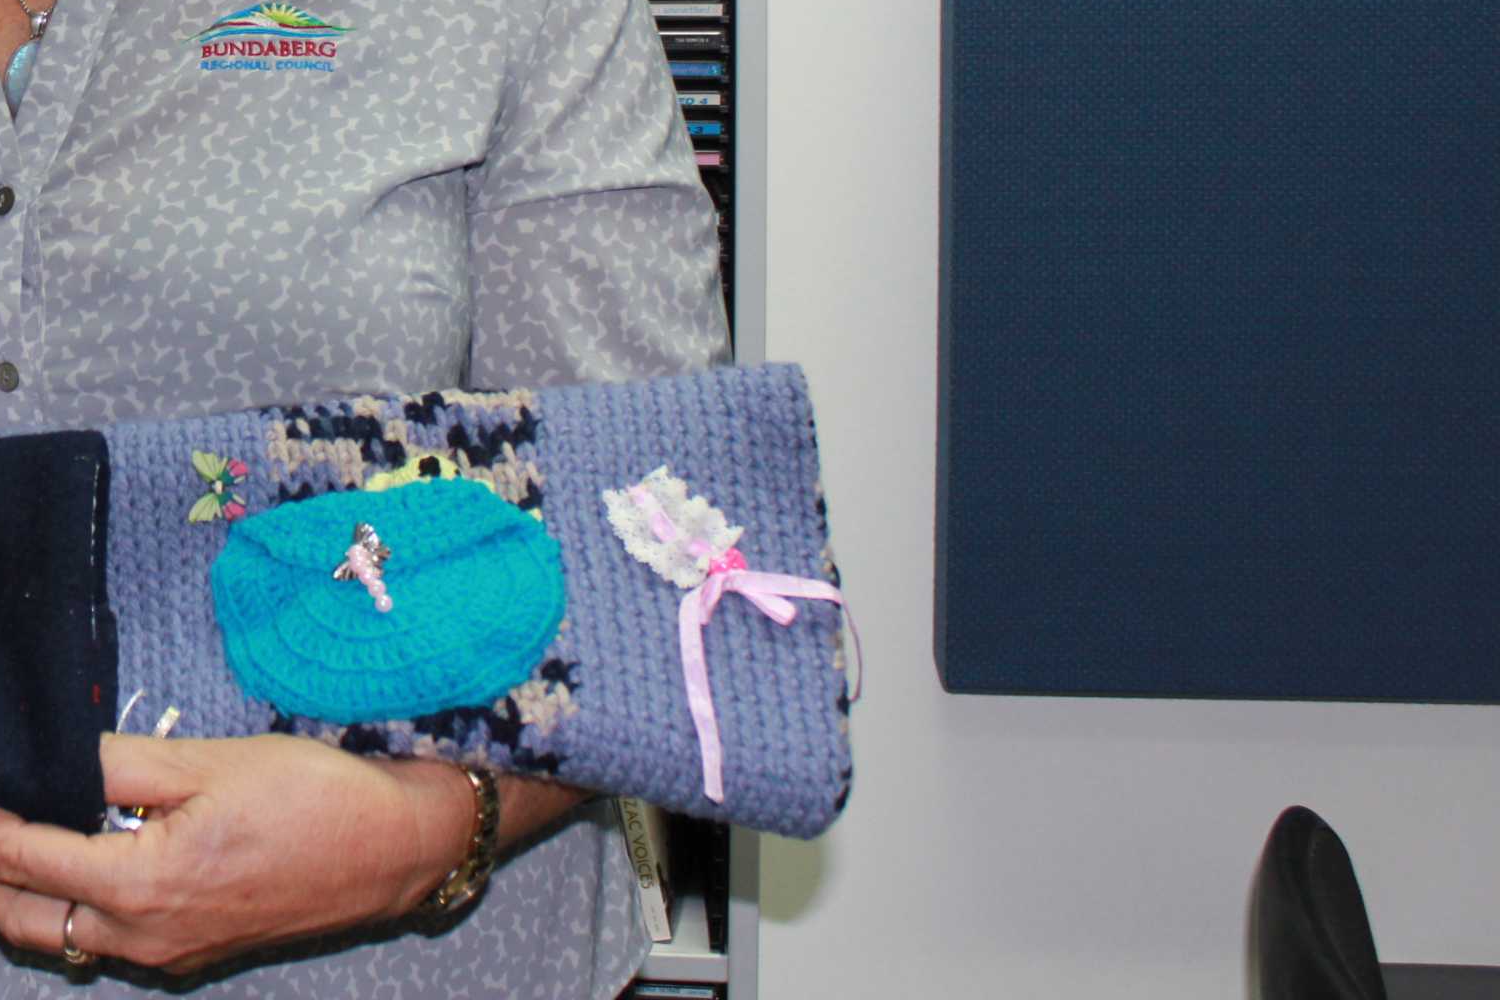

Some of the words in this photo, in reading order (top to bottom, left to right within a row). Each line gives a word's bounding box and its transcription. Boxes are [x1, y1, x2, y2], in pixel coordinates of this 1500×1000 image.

[201, 40, 337, 58] BUNDABERG
[201, 60, 270, 71] REGIONAL
[275, 60, 335, 72] COUNCIL
[632, 834, 654, 889] VOICES
